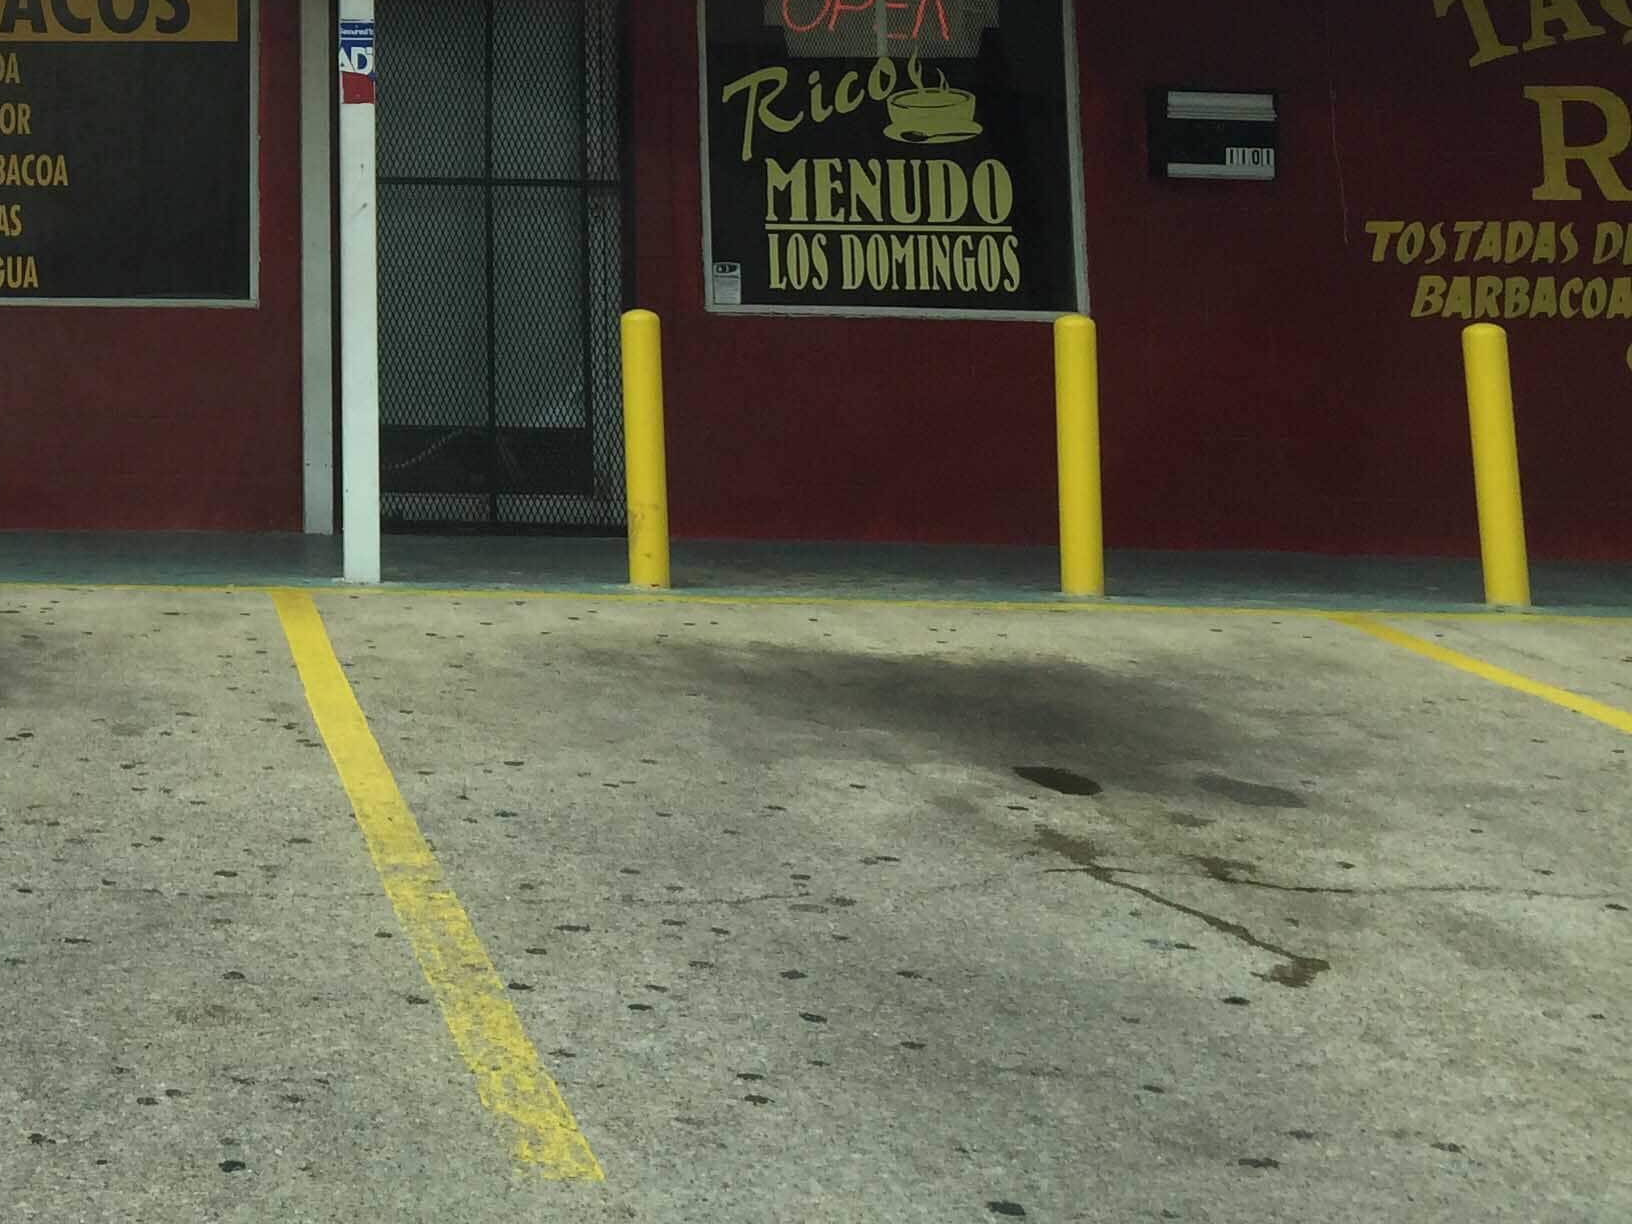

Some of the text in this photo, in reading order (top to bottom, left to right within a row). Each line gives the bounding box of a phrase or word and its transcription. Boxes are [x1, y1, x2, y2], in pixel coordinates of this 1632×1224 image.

[722, 55, 897, 162] Rico
[1228, 149, 1271, 166] 1101
[1523, 85, 1632, 202] R
[764, 158, 1013, 224] MENUDO
[767, 233, 1021, 292] LOS DOMINGOS
[1364, 220, 1579, 265] TOSTADAS
[1410, 275, 1632, 319] BARBACOA
